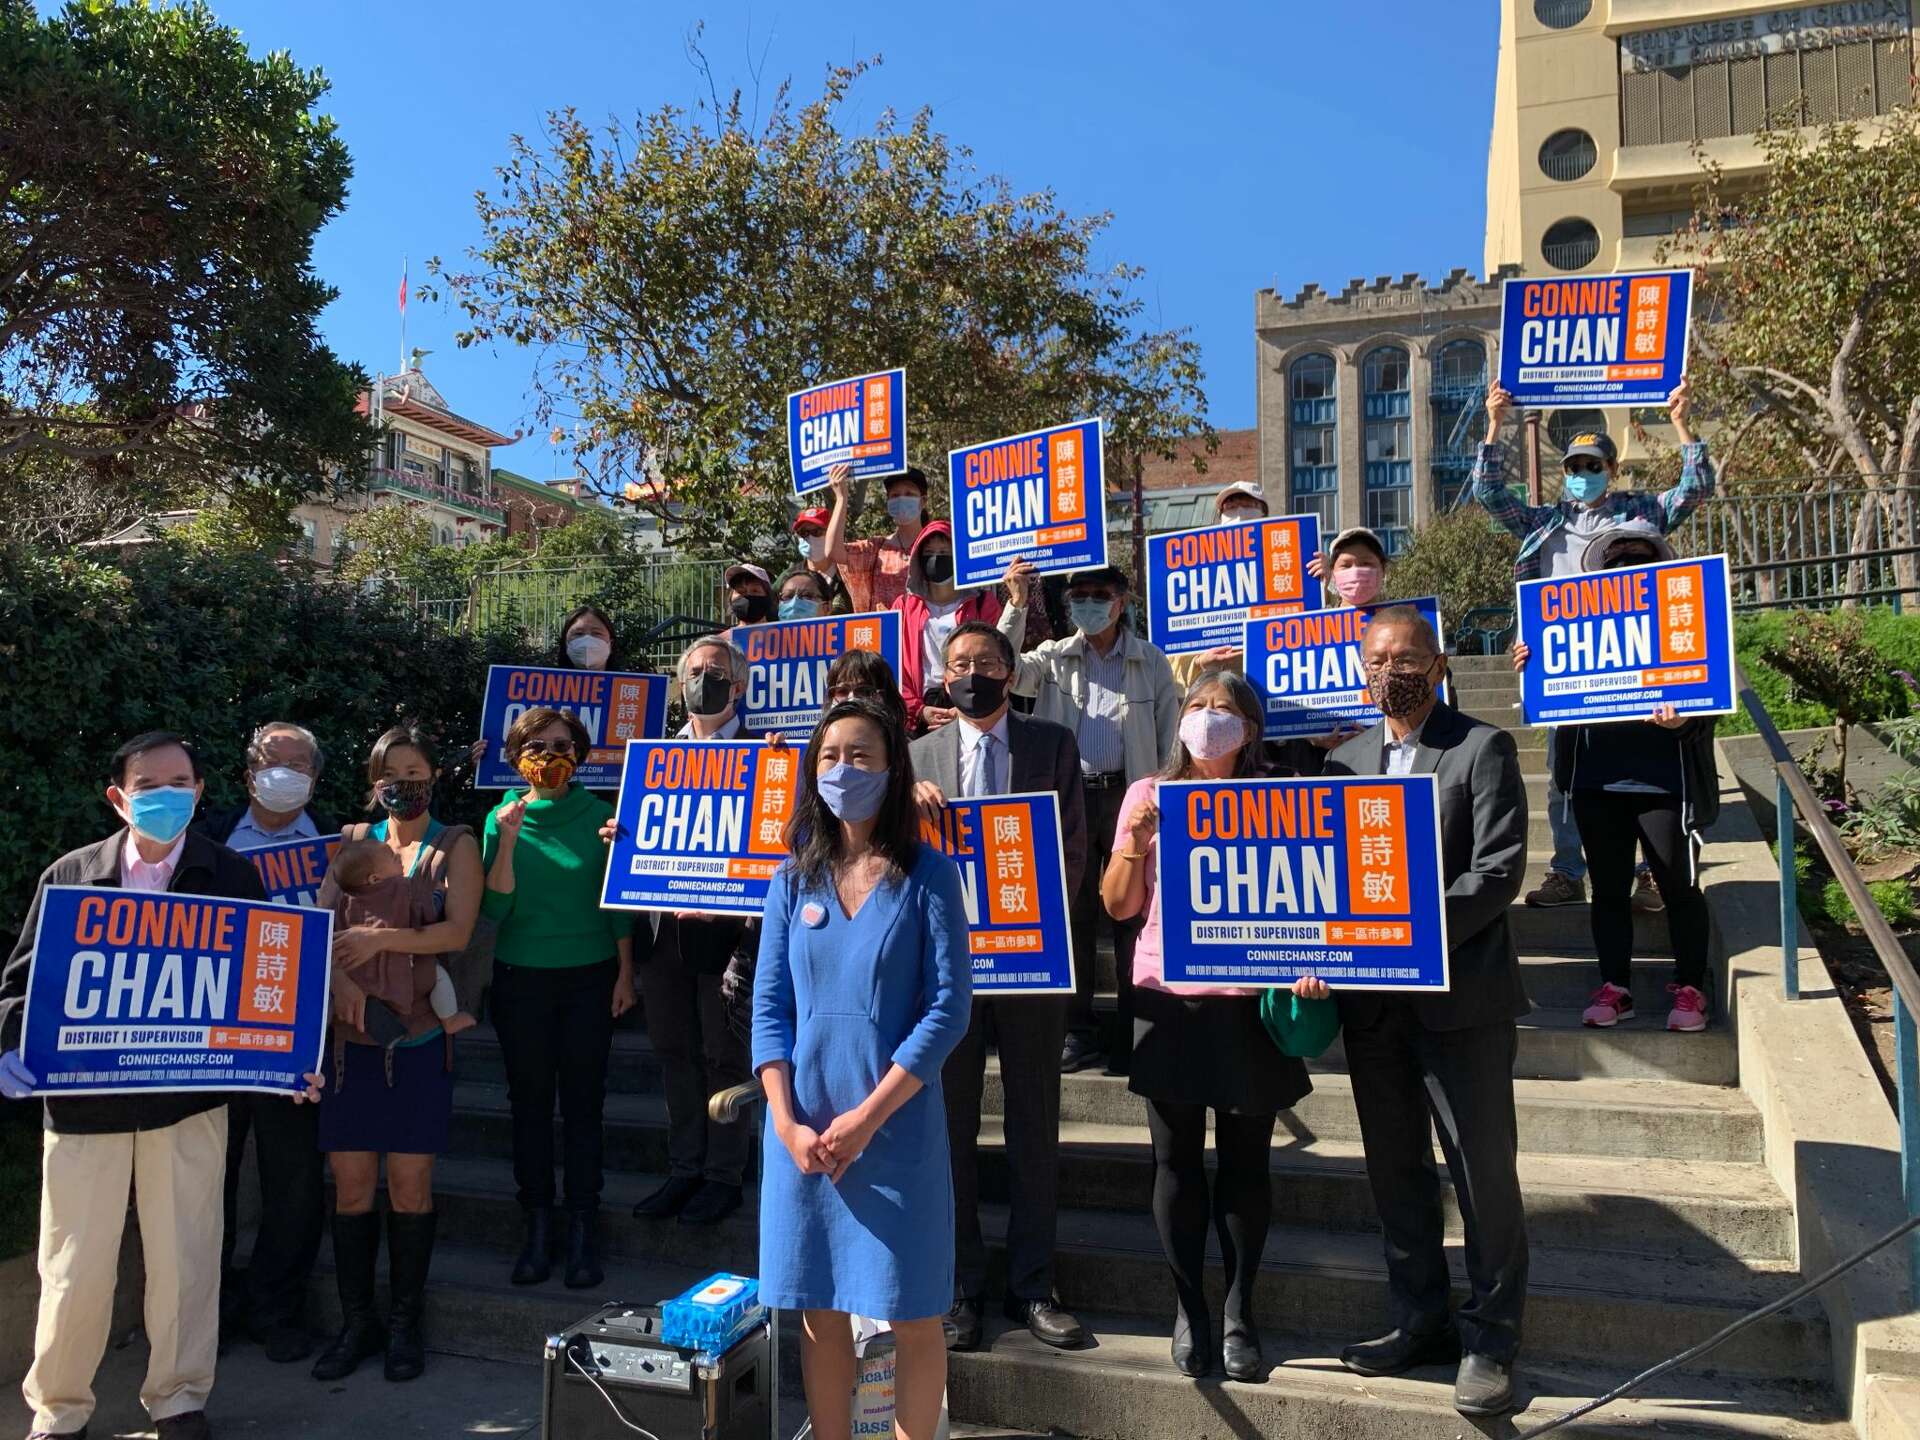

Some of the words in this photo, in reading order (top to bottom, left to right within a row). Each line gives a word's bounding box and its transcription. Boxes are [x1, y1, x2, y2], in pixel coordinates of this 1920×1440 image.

[1523, 280, 1623, 317] CONNIE
[1634, 285, 1660, 354] 陳詩敏
[1520, 317, 1620, 365] CHAN
[1523, 370, 1553, 379] DISTRICT
[1560, 368, 1604, 378] SUPERVISOR
[1554, 383, 1624, 393] CONNIECHANSF.COM
[800, 382, 860, 420] CONNIE
[800, 409, 860, 457] CHAN
[965, 437, 1043, 488] CONNIE
[1056, 440, 1077, 513] 陳詩敏
[967, 477, 1044, 538] CHAN
[971, 541, 995, 554] DISTRICT
[999, 535, 1034, 548] SUPERVISOR
[1166, 526, 1256, 569] CONNIE
[1270, 529, 1294, 593] 陳詩敏
[1166, 561, 1258, 613] CHAN
[1540, 572, 1650, 622] CONNIE
[1171, 616, 1200, 627] DISTRICT
[1207, 611, 1247, 623] SUPERVISOR
[1266, 611, 1367, 651] CONNIE
[1666, 576, 1696, 654] 陳詩敏
[747, 622, 838, 662] CONNIE
[1542, 614, 1651, 675] CHAN
[507, 671, 606, 704] CONNIE
[1266, 645, 1367, 694] CHAN
[1548, 680, 1581, 692] DISTRICT
[1589, 675, 1638, 687] SUPERVISOR
[615, 683, 640, 740] 陳詩敏
[748, 716, 778, 726] DISTRICT
[784, 713, 823, 724] SUPERVISO
[1271, 698, 1304, 709] DISTRICT
[1311, 694, 1359, 706] SUPERVISOR
[1584, 690, 1663, 704] CONNIECHANSF.COM
[644, 748, 751, 790] CONNIE
[635, 793, 745, 853] CHAN
[759, 757, 789, 845] 陳詩敏
[1187, 787, 1334, 840] CONNIE
[920, 807, 974, 856] NIE
[1358, 797, 1396, 904] 陳詩敏
[253, 846, 321, 891] NIE
[635, 859, 669, 871] DISTRICT
[677, 861, 725, 873] SUPERVISOR
[668, 880, 744, 893] CONNIECHANSF.COM
[993, 815, 1028, 913] 陳詩敏
[1189, 845, 1338, 914] CHAN
[75, 897, 236, 952] CONNIE
[1196, 926, 1243, 939] DISTRICT
[1246, 926, 1251, 939] 1
[1254, 926, 1320, 939] SUPERVISOR
[252, 921, 290, 1014] 陳詩敏
[1247, 950, 1353, 962] CONNIECHANSF.COM
[63, 951, 231, 1020] CHAN
[64, 1031, 118, 1045] DISTRICT
[130, 1030, 203, 1043] SUPERVISOR
[118, 1054, 234, 1066] CONNIECHANSF.COM
[852, 1419, 889, 1434] lass
